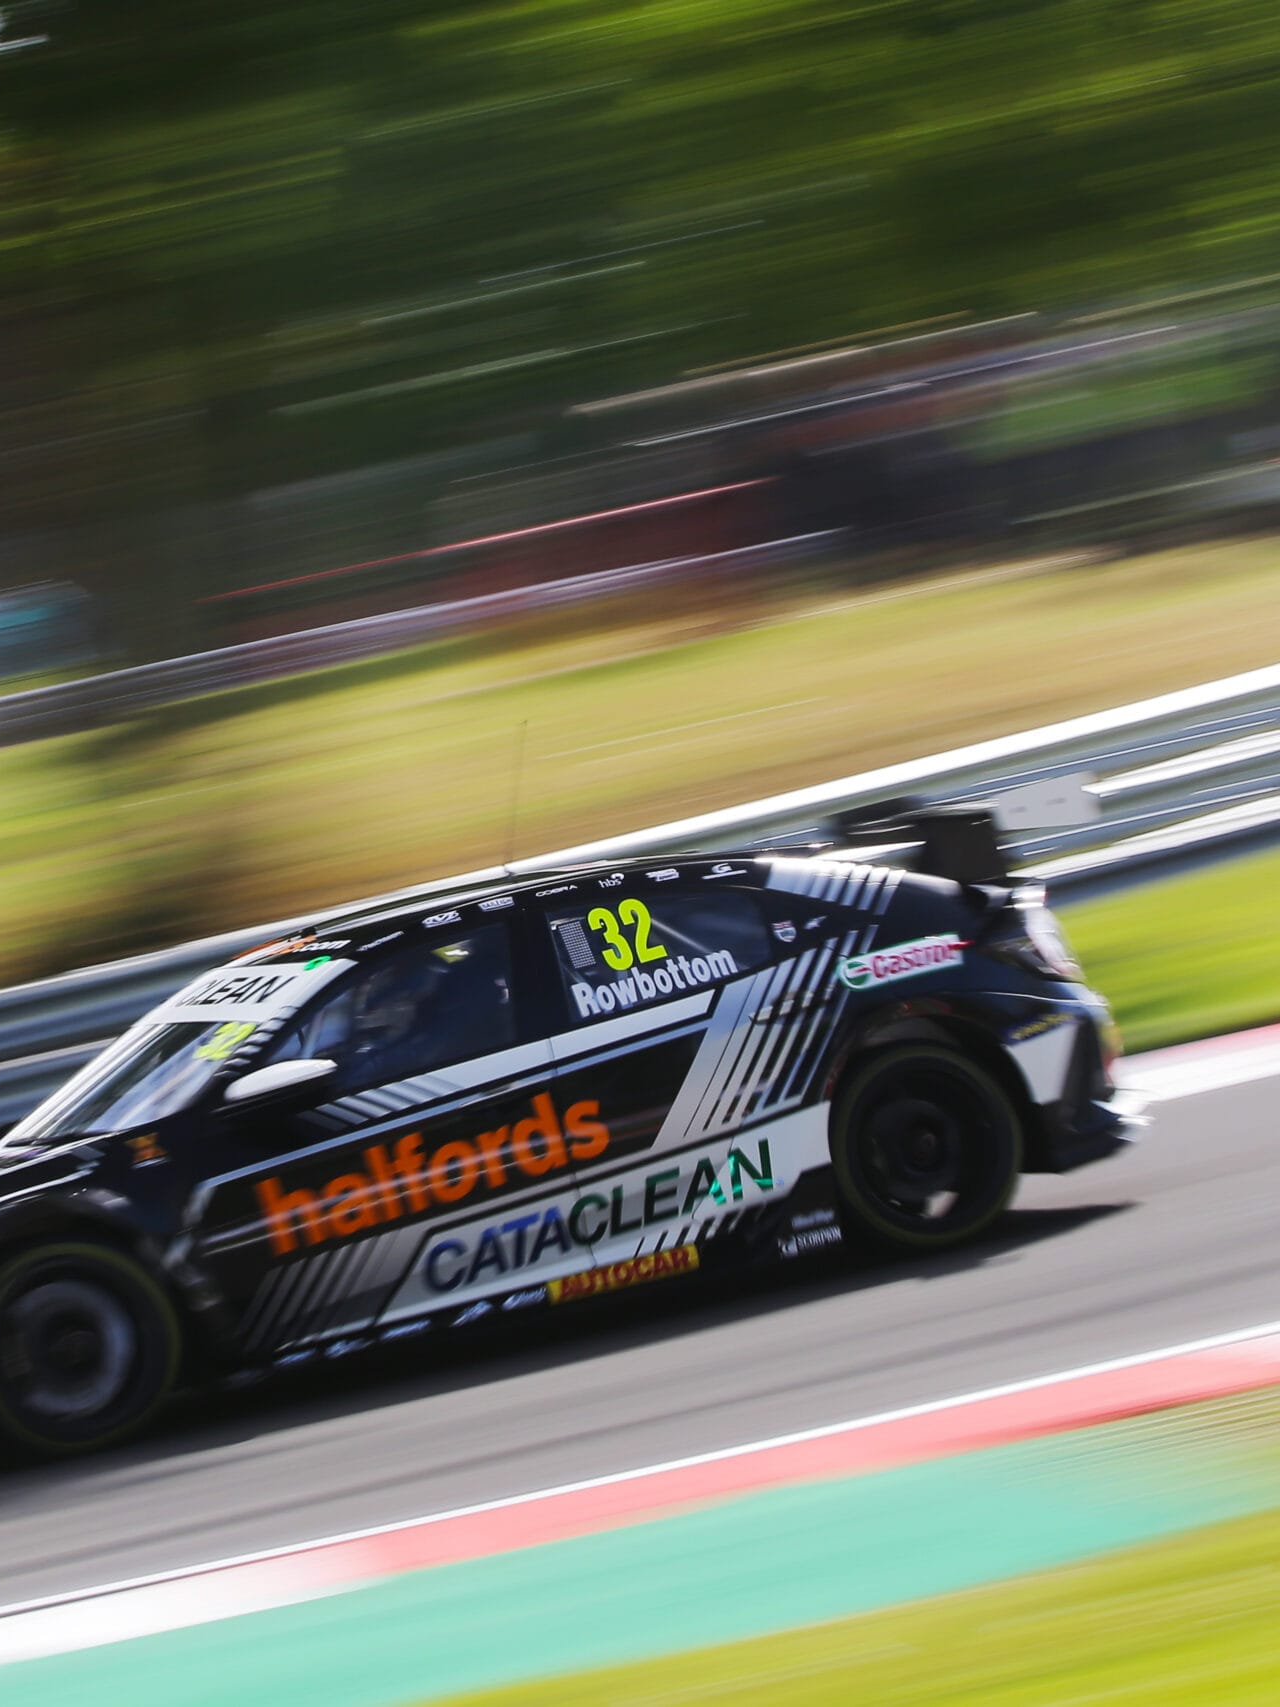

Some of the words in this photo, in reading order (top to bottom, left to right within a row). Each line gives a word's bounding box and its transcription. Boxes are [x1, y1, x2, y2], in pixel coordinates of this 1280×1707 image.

[535, 884, 578, 897] COBRA
[586, 898, 669, 971] 32
[571, 949, 739, 1018] Rowbottom
[255, 1091, 611, 1257] halfords
[423, 1137, 775, 1293] CATACLEAN
[559, 1245, 691, 1300] AUTOCAR
